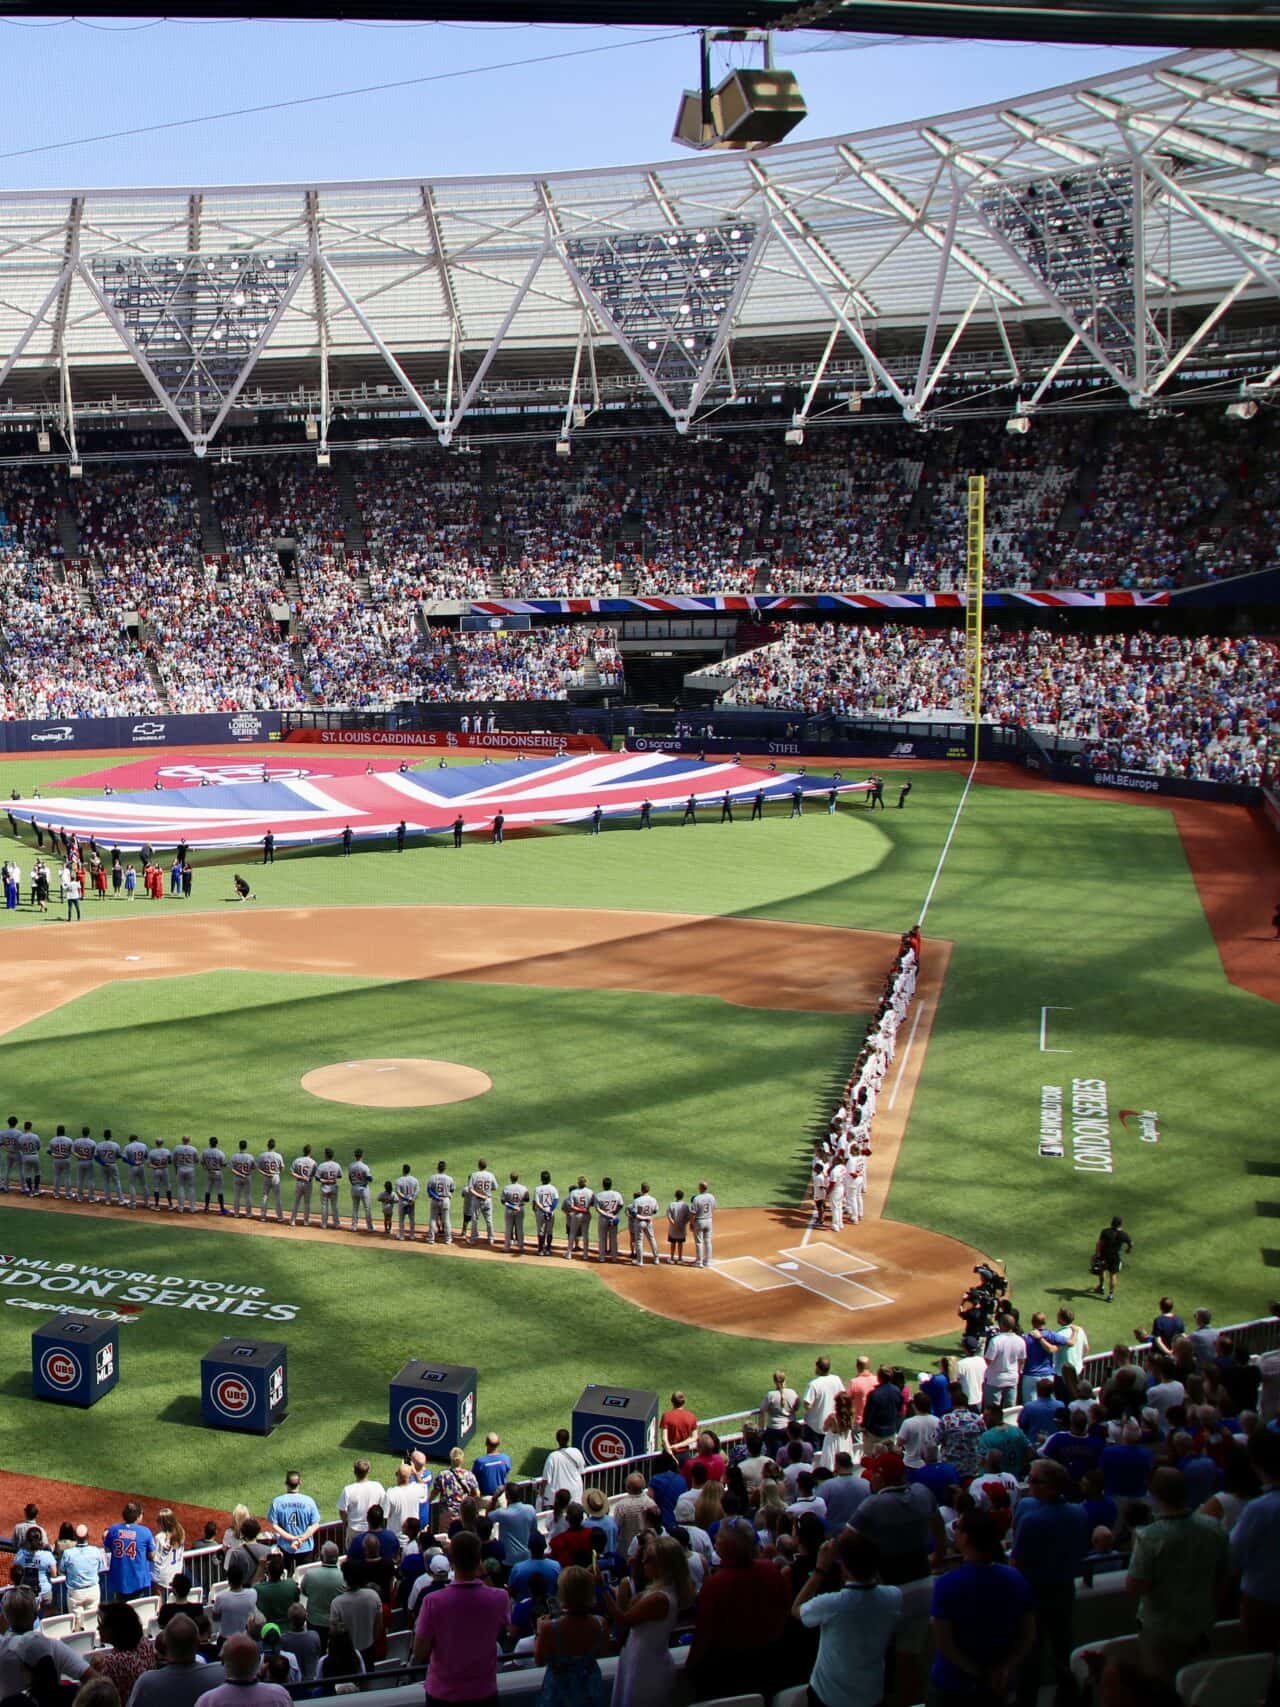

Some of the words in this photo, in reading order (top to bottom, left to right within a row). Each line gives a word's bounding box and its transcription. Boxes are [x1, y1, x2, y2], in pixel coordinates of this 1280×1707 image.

[321, 731, 337, 743] ST.
[338, 732, 371, 743] LOUIS
[372, 732, 437, 745] CARDINALS
[469, 734, 568, 748] #LONDONSERIES
[649, 741, 681, 749] sorare
[768, 743, 800, 754] STIFEL
[1094, 772, 1159, 791] @MLBEurope
[1072, 1078, 1109, 1116] SERIES
[1072, 1117, 1113, 1173] LONDON
[14, 1257, 75, 1273] MLB
[78, 1263, 185, 1288] WORLD
[189, 1279, 265, 1298] TOUR
[120, 1286, 301, 1322] SERIES
[96, 1362, 114, 1385] MLB
[288, 1511, 299, 1527] 4
[113, 1539, 137, 1560] 34
